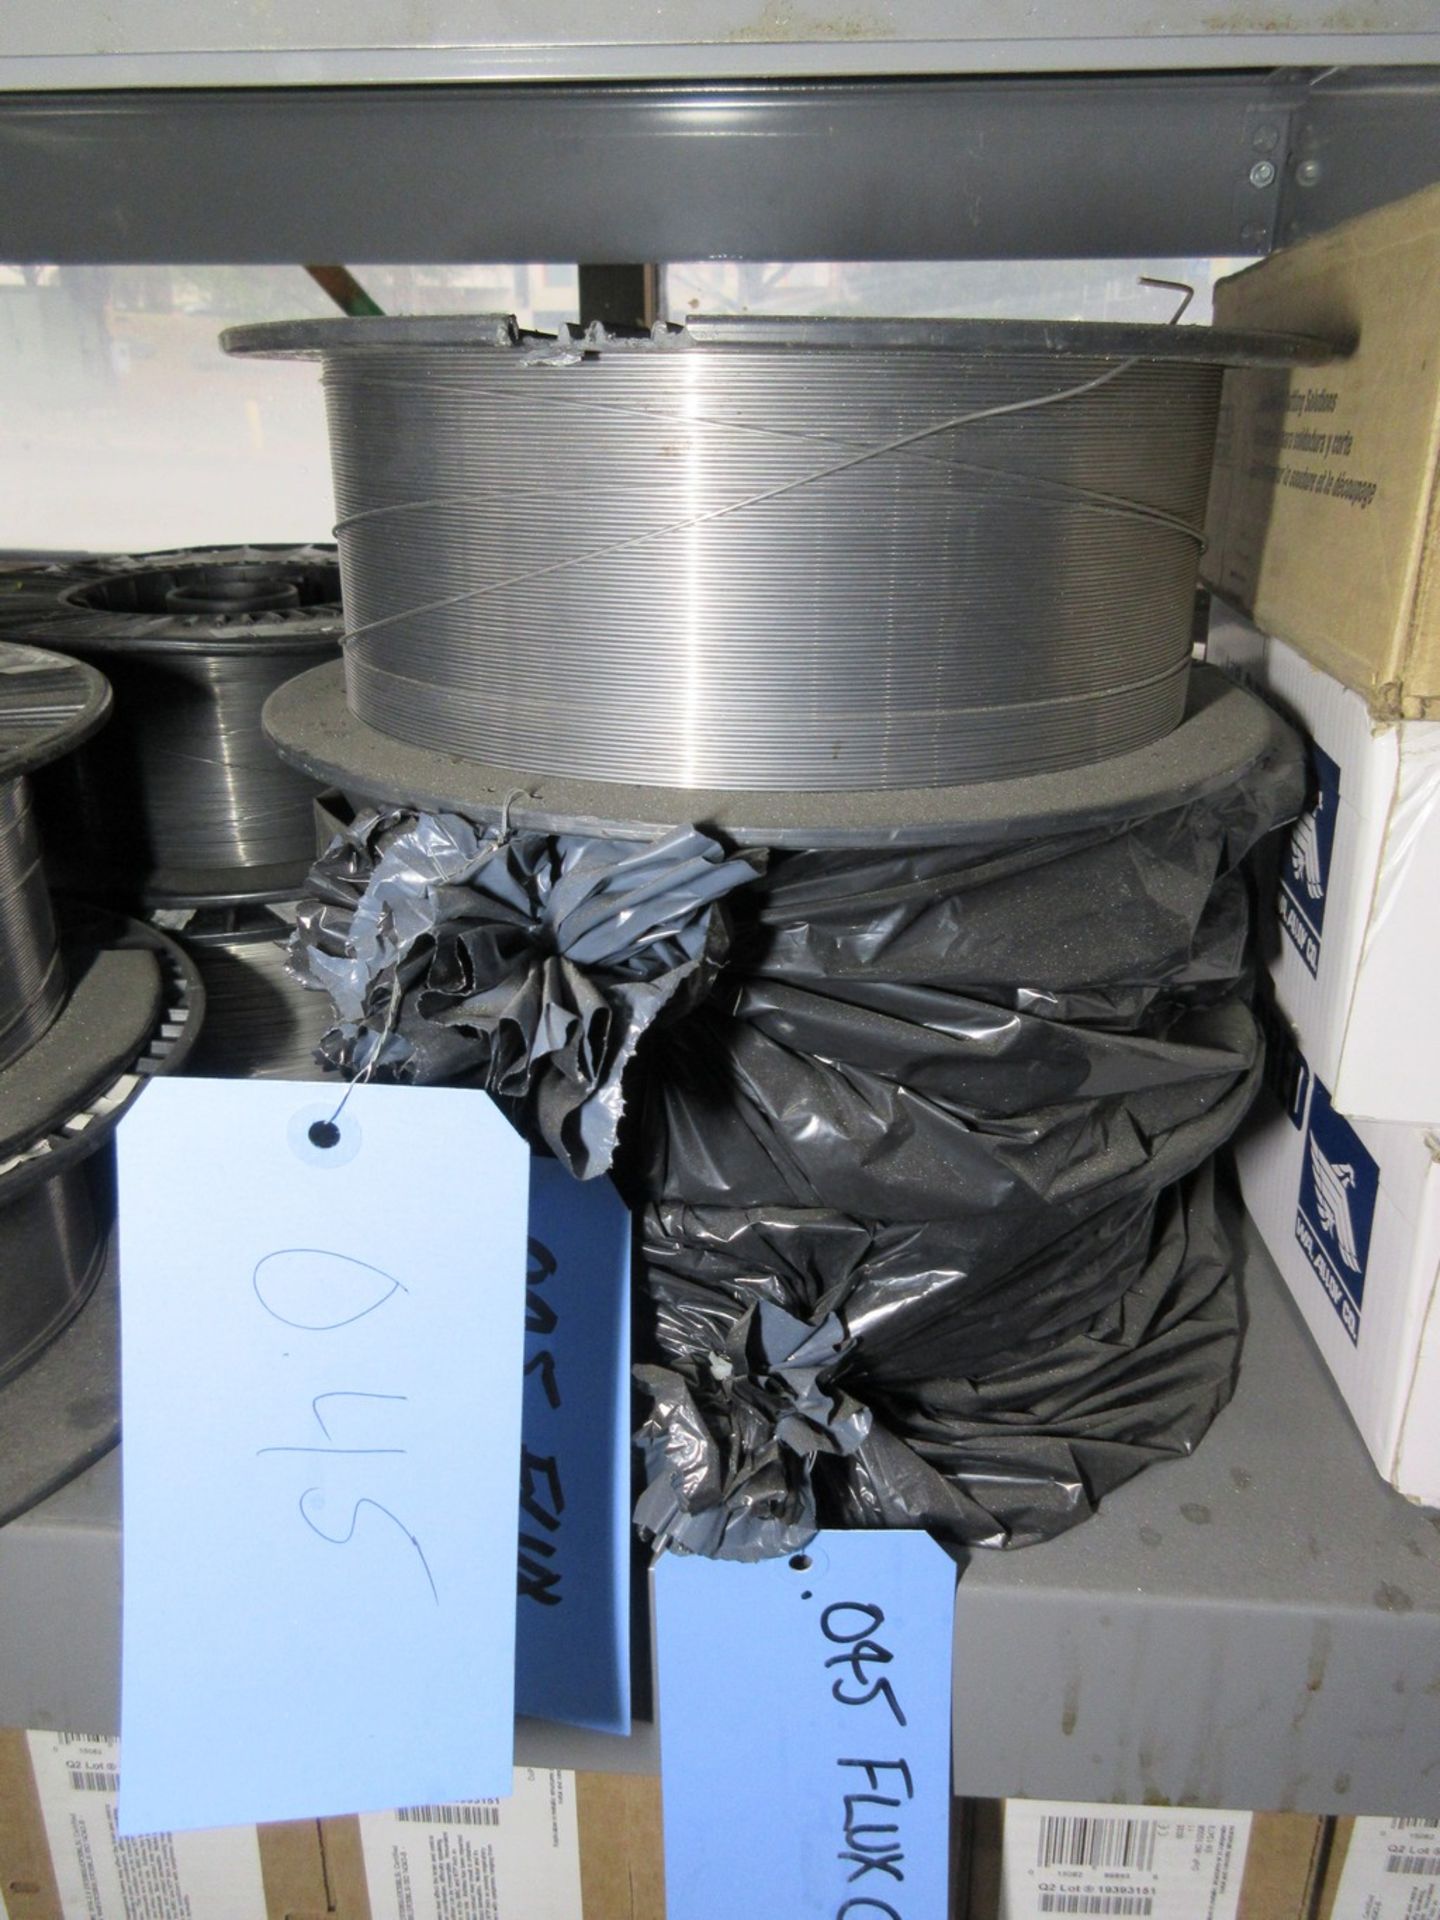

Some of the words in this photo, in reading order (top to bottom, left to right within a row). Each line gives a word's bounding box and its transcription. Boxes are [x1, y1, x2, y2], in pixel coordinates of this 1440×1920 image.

[1304, 388, 1338, 414] Solutions
[1331, 430, 1353, 456] corte
[1331, 471, 1377, 509] découpage
[836, 1757, 914, 1884] FLUX
[1037, 1882, 1056, 1892] Q2
[1059, 1883, 1080, 1893] Lot
